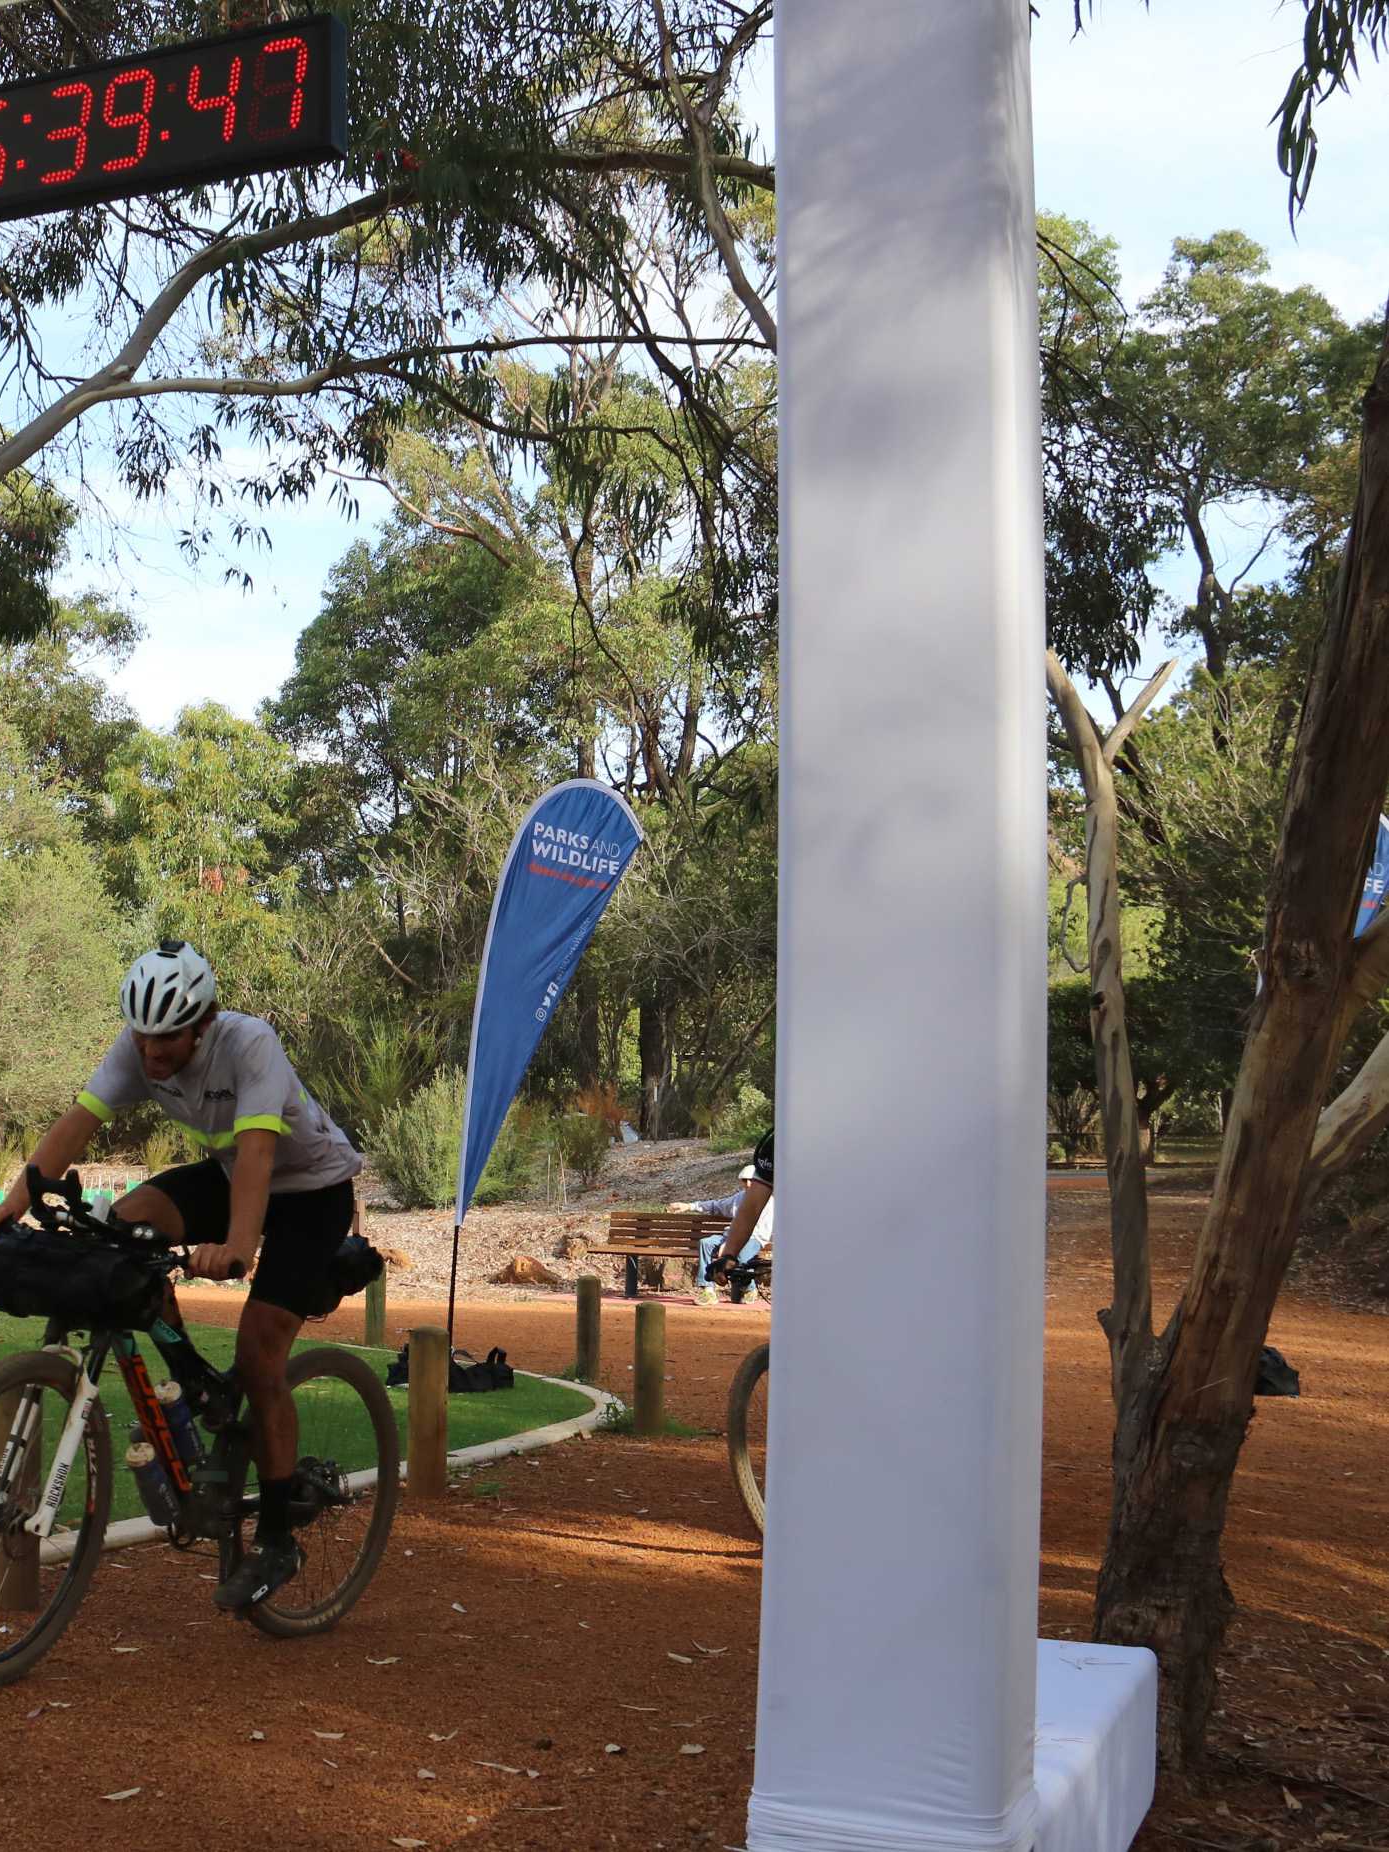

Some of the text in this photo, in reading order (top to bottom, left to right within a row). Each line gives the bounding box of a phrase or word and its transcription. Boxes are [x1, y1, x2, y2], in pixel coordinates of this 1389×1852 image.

[532, 839, 620, 875] WILDLIFE
[533, 821, 621, 858] PARKS AND
